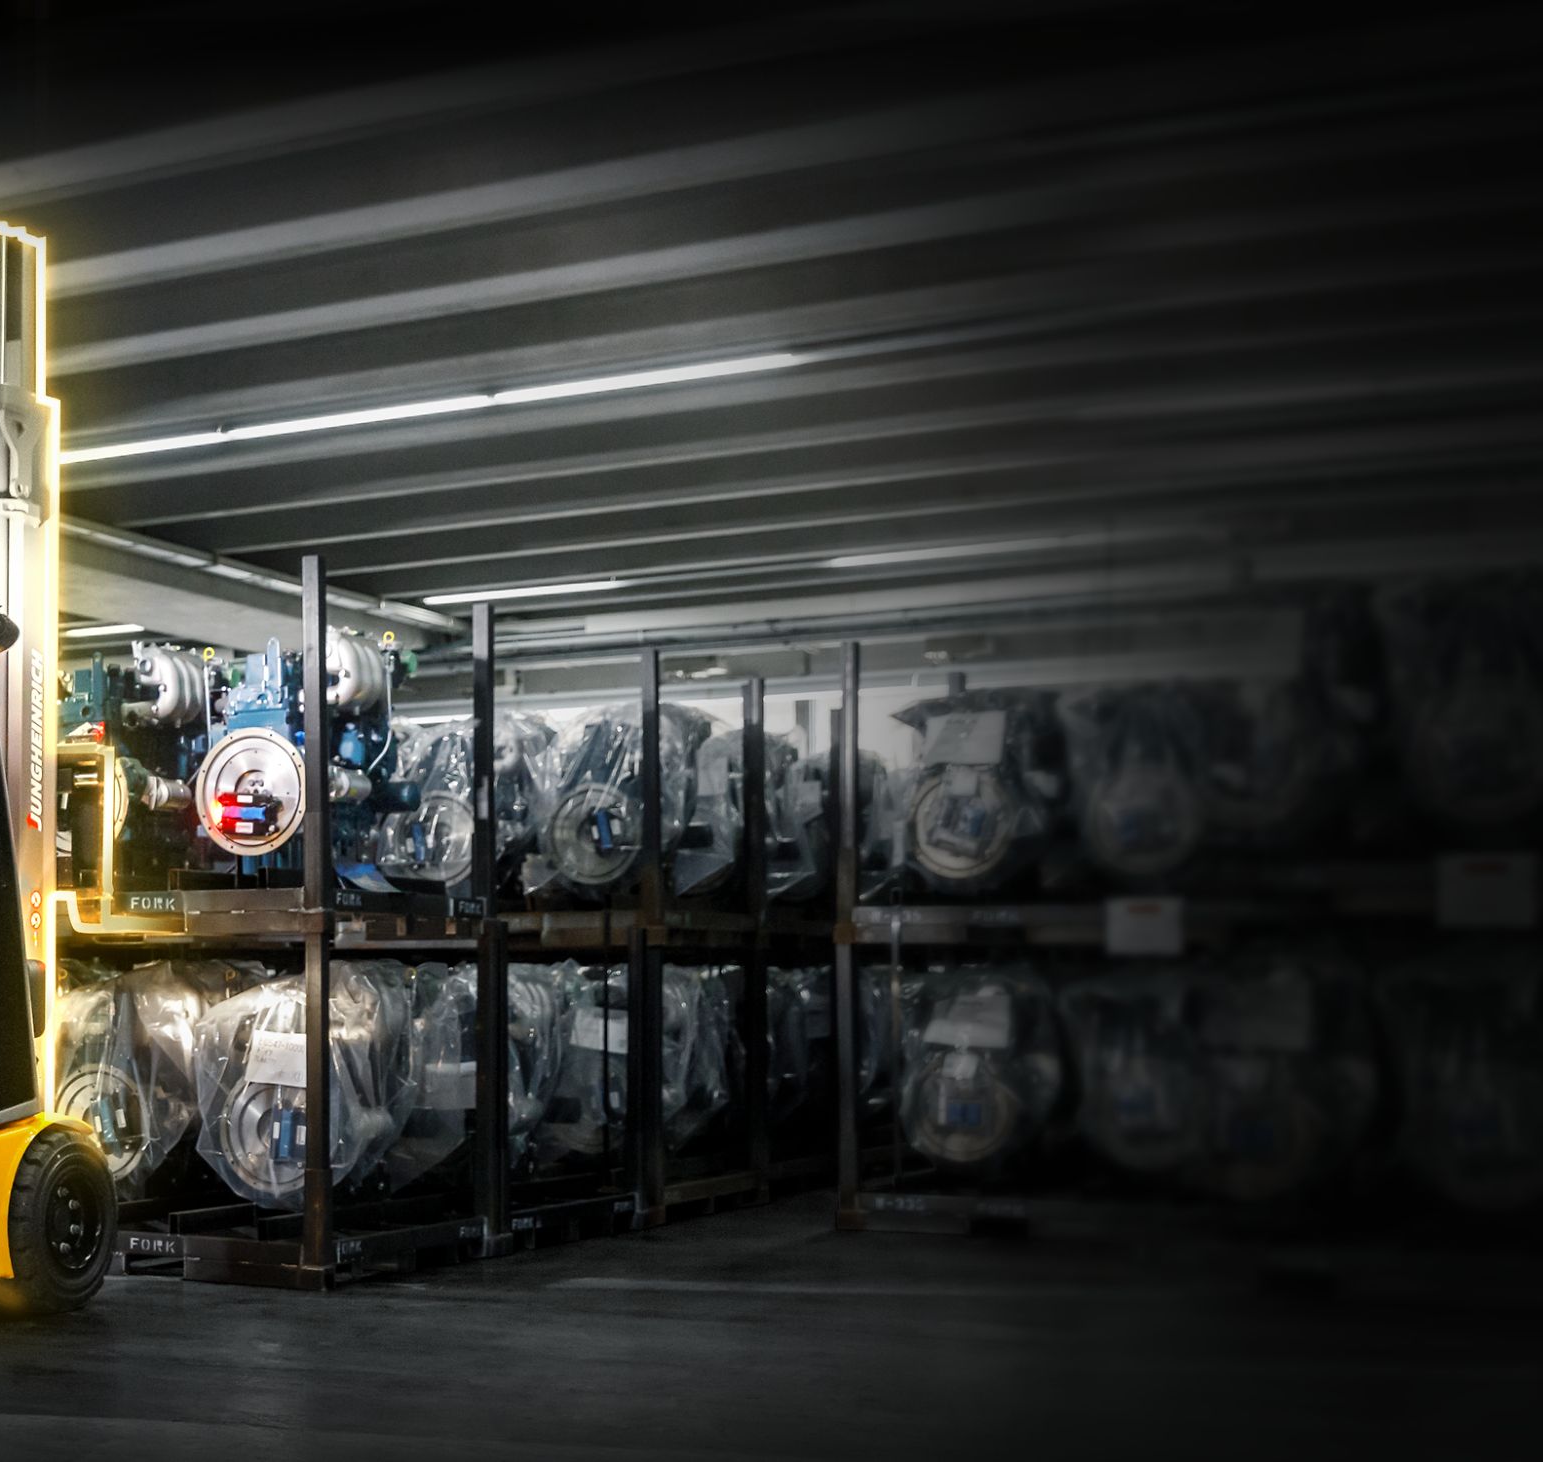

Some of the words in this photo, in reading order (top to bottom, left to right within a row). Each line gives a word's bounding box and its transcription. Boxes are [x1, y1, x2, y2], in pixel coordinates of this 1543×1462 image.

[28, 648, 44, 832] JUNGHEINRICH
[130, 896, 176, 911] FORK
[336, 892, 362, 907] FORK
[129, 1237, 176, 1254] FORK
